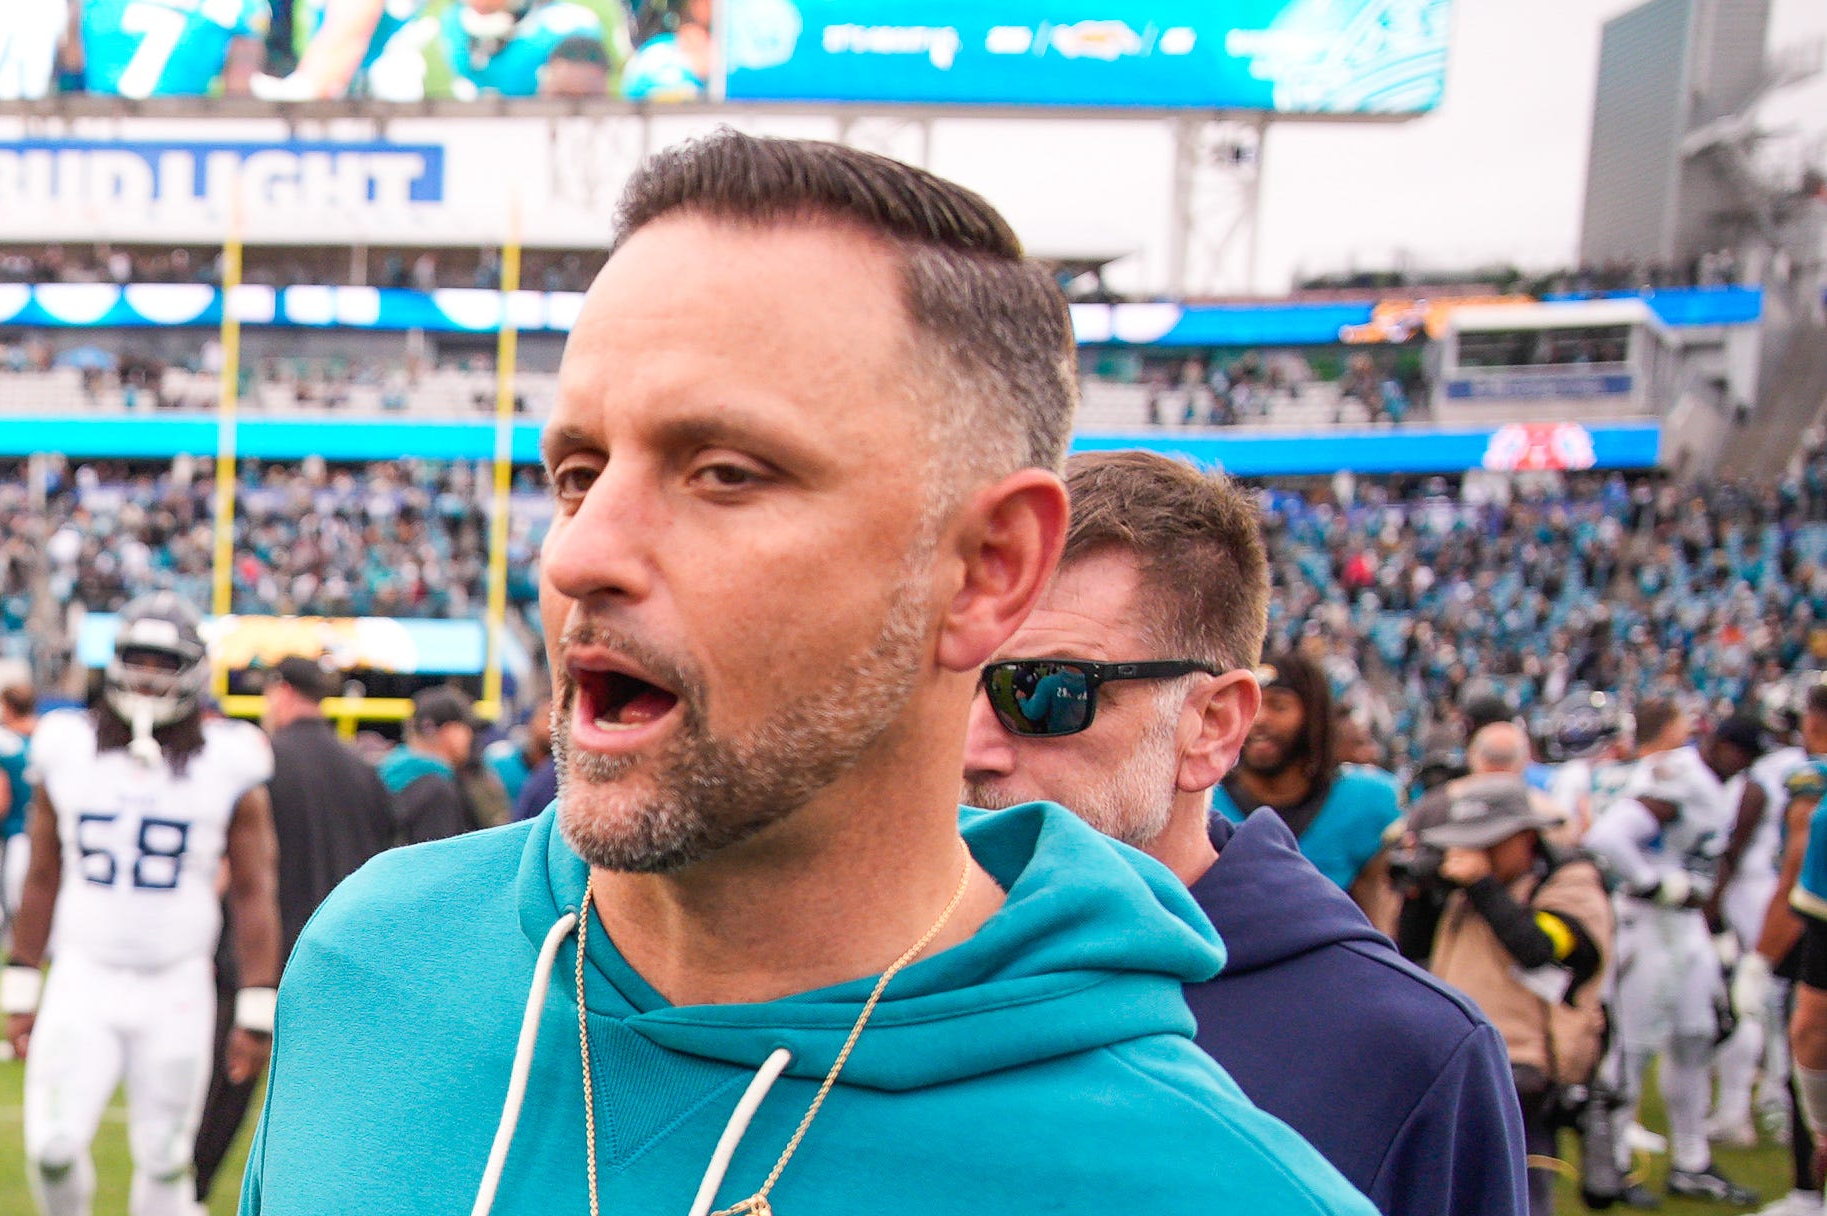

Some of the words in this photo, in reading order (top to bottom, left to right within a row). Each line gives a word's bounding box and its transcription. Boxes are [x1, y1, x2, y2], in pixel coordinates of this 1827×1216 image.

[118, 3, 186, 99] 7
[161, 152, 422, 213] LIGHT
[78, 813, 190, 888] 58
